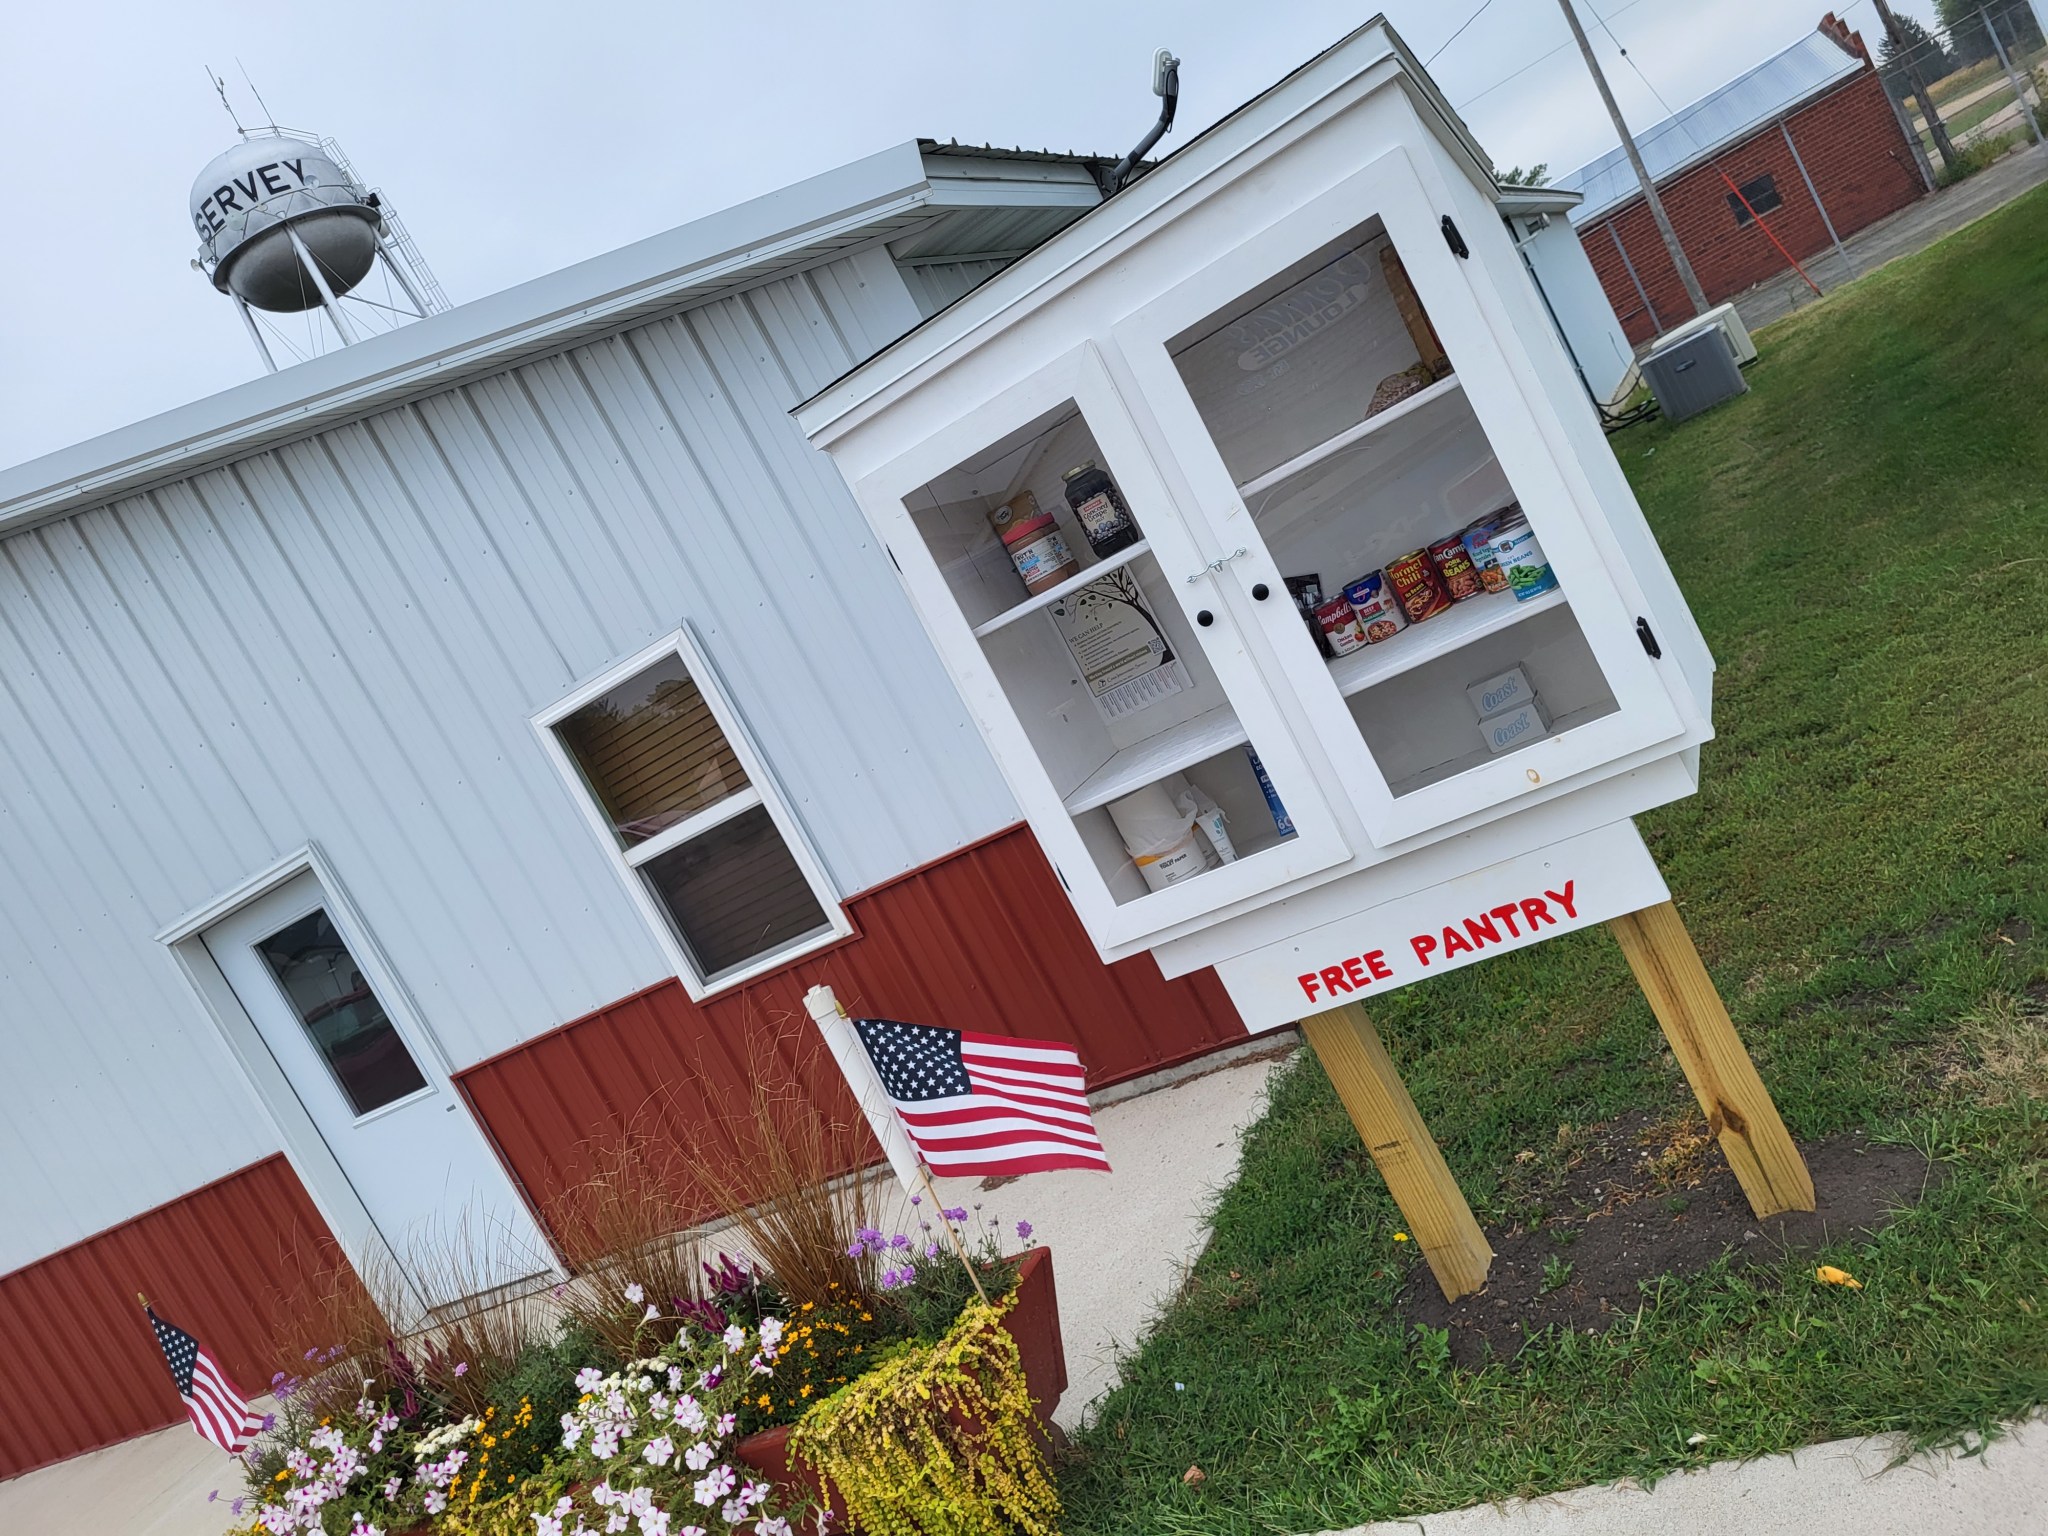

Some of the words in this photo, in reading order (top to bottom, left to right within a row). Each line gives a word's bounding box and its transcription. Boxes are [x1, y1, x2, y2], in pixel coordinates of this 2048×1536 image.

[195, 158, 307, 242] SERVEY
[1443, 559, 1470, 577] BEANS
[1513, 550, 1533, 563] BEANS
[1396, 570, 1421, 588] Chili
[1077, 630, 1090, 640] CAN
[1089, 622, 1104, 634] HELP
[1482, 676, 1518, 712] Coast
[1493, 711, 1530, 747] Coast
[1298, 949, 1394, 1003] FREE
[1410, 879, 1578, 967] PANTRY
